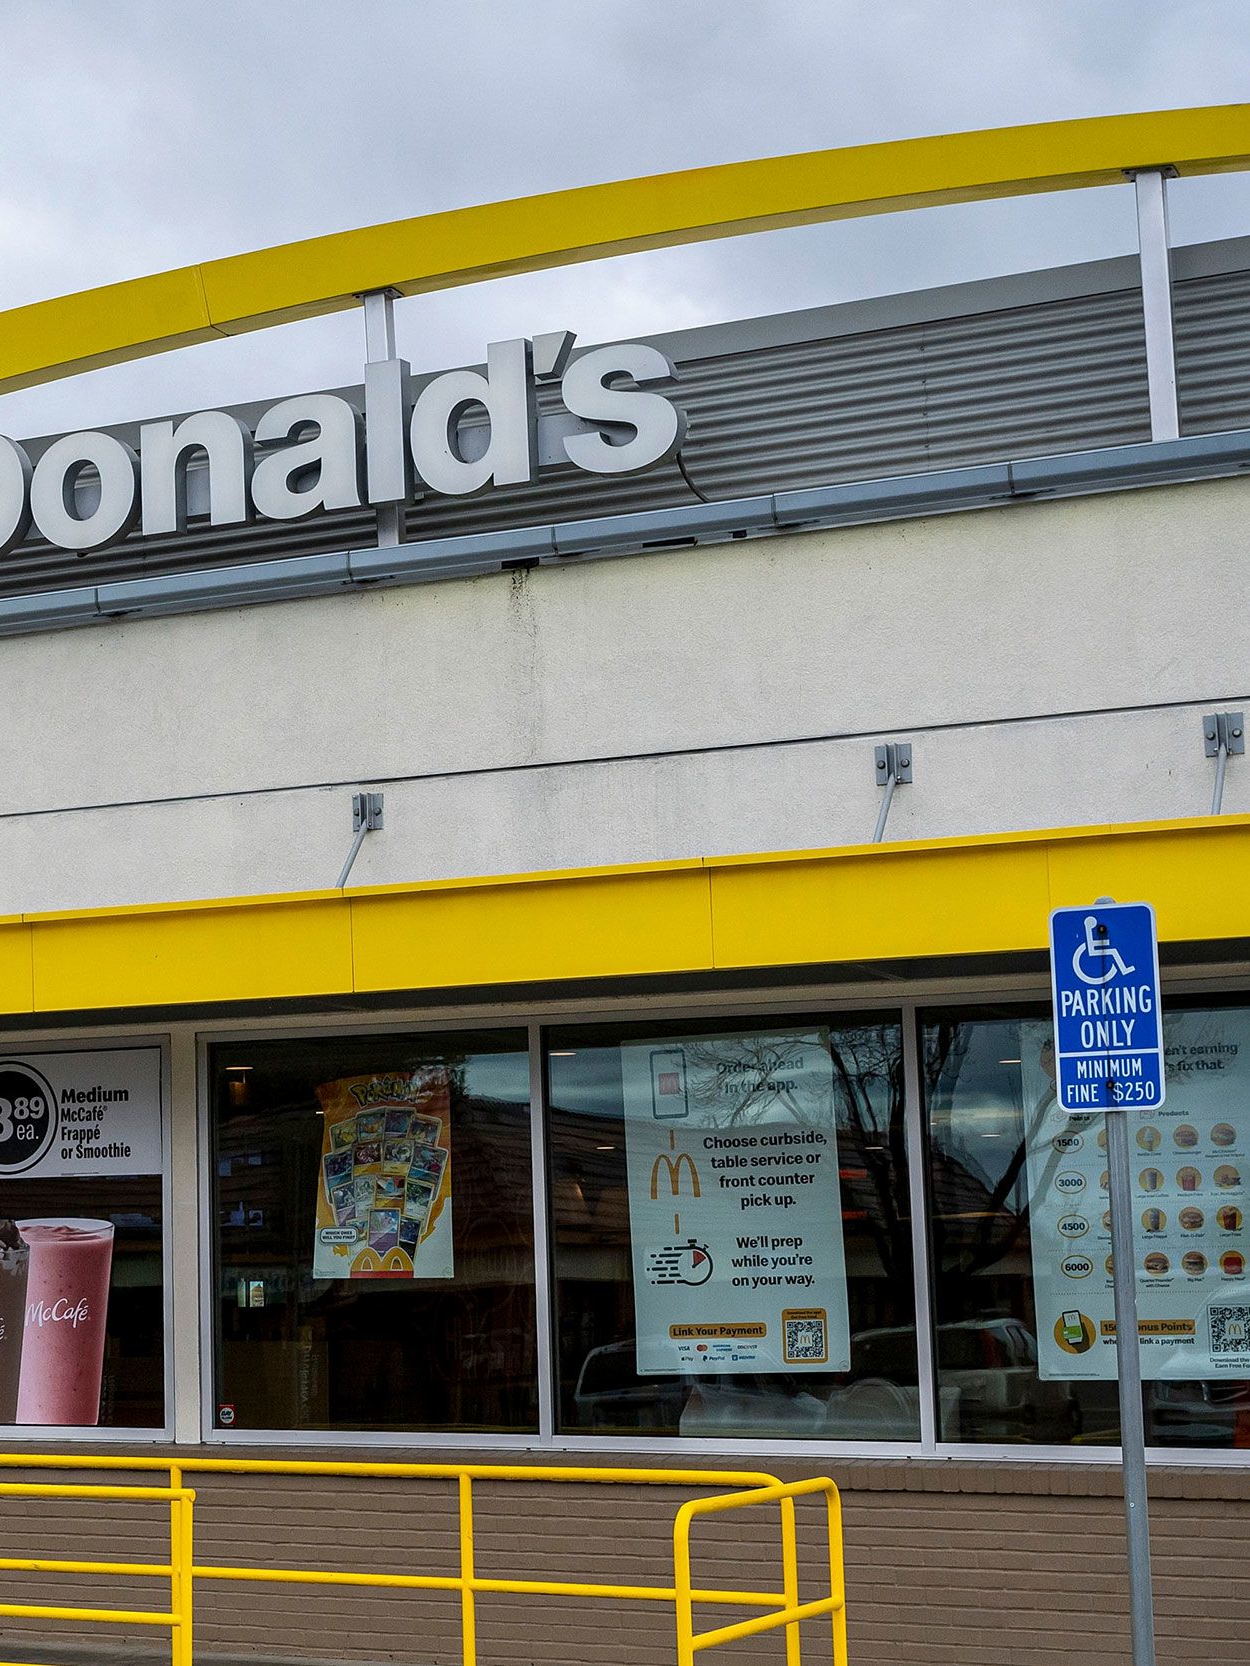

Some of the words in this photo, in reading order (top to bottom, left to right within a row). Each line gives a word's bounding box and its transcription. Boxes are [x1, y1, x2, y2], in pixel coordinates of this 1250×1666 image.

[1061, 985, 1152, 1017] PARKING
[1080, 1019, 1135, 1048] ONLY
[1190, 1043, 1238, 1055] earning
[1077, 1058, 1142, 1079] MINIMUM
[61, 1085, 129, 1104] Medium
[767, 1080, 798, 1094] app.
[1067, 1084, 1099, 1103] FINE
[1113, 1081, 1155, 1103] $250
[1158, 1110, 1189, 1118] Products
[16, 1123, 39, 1140] ea.
[61, 1123, 101, 1144] Frappé
[703, 1136, 758, 1150] Choose
[760, 1131, 827, 1146] curbside,
[1057, 1139, 1079, 1147] 1500
[61, 1148, 73, 1160] or
[76, 1143, 131, 1159] Smoothie
[710, 1155, 748, 1169] table
[750, 1154, 803, 1167] service
[806, 1152, 821, 1164] or
[719, 1175, 755, 1188] front
[758, 1173, 815, 1187] counter
[1058, 1179, 1083, 1187] 3000
[740, 1194, 772, 1210] pick
[774, 1195, 797, 1209] up.
[1061, 1223, 1086, 1231] 4500
[736, 1236, 768, 1249] We'll
[771, 1236, 803, 1251] prep
[731, 1255, 769, 1268] while
[771, 1254, 813, 1269] you're
[1064, 1263, 1090, 1271] 6000
[732, 1276, 749, 1287] on
[752, 1275, 782, 1290] your
[785, 1274, 815, 1288] way.
[25, 1297, 89, 1328] McCafé
[673, 1327, 693, 1336] Link
[697, 1327, 718, 1336] Your
[720, 1326, 763, 1338] Payment
[1161, 1323, 1192, 1332] Points
[1161, 1338, 1195, 1346] payment
